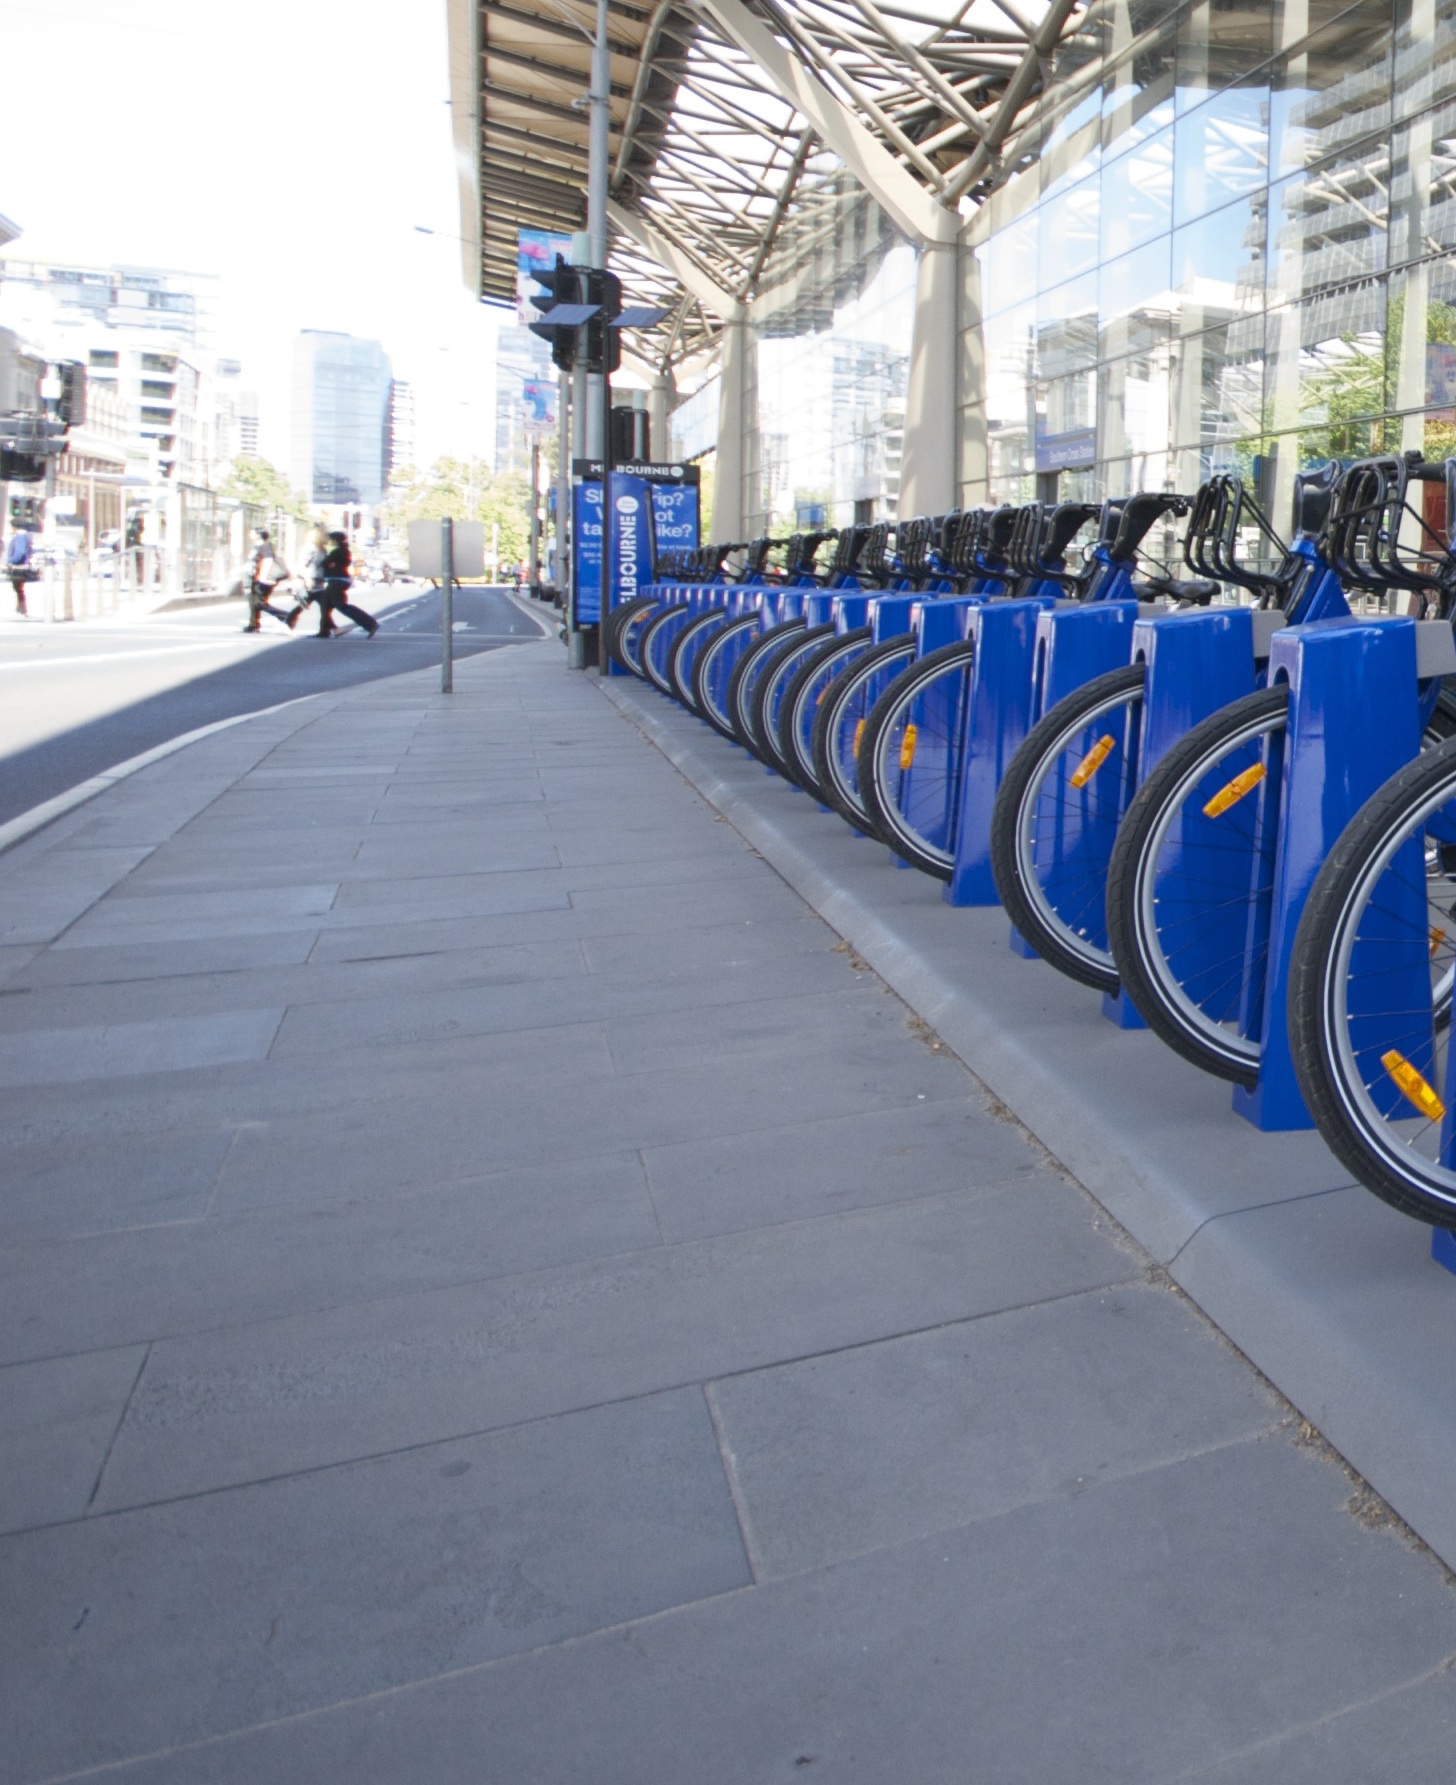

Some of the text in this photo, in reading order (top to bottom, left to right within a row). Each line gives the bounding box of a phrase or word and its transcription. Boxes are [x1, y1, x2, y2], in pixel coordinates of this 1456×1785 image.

[590, 463, 669, 475] MBOURNE
[652, 491, 684, 508] rip?
[655, 509, 674, 522] ot
[582, 521, 692, 538] ta ike?
[620, 515, 637, 603] LBOURNE
